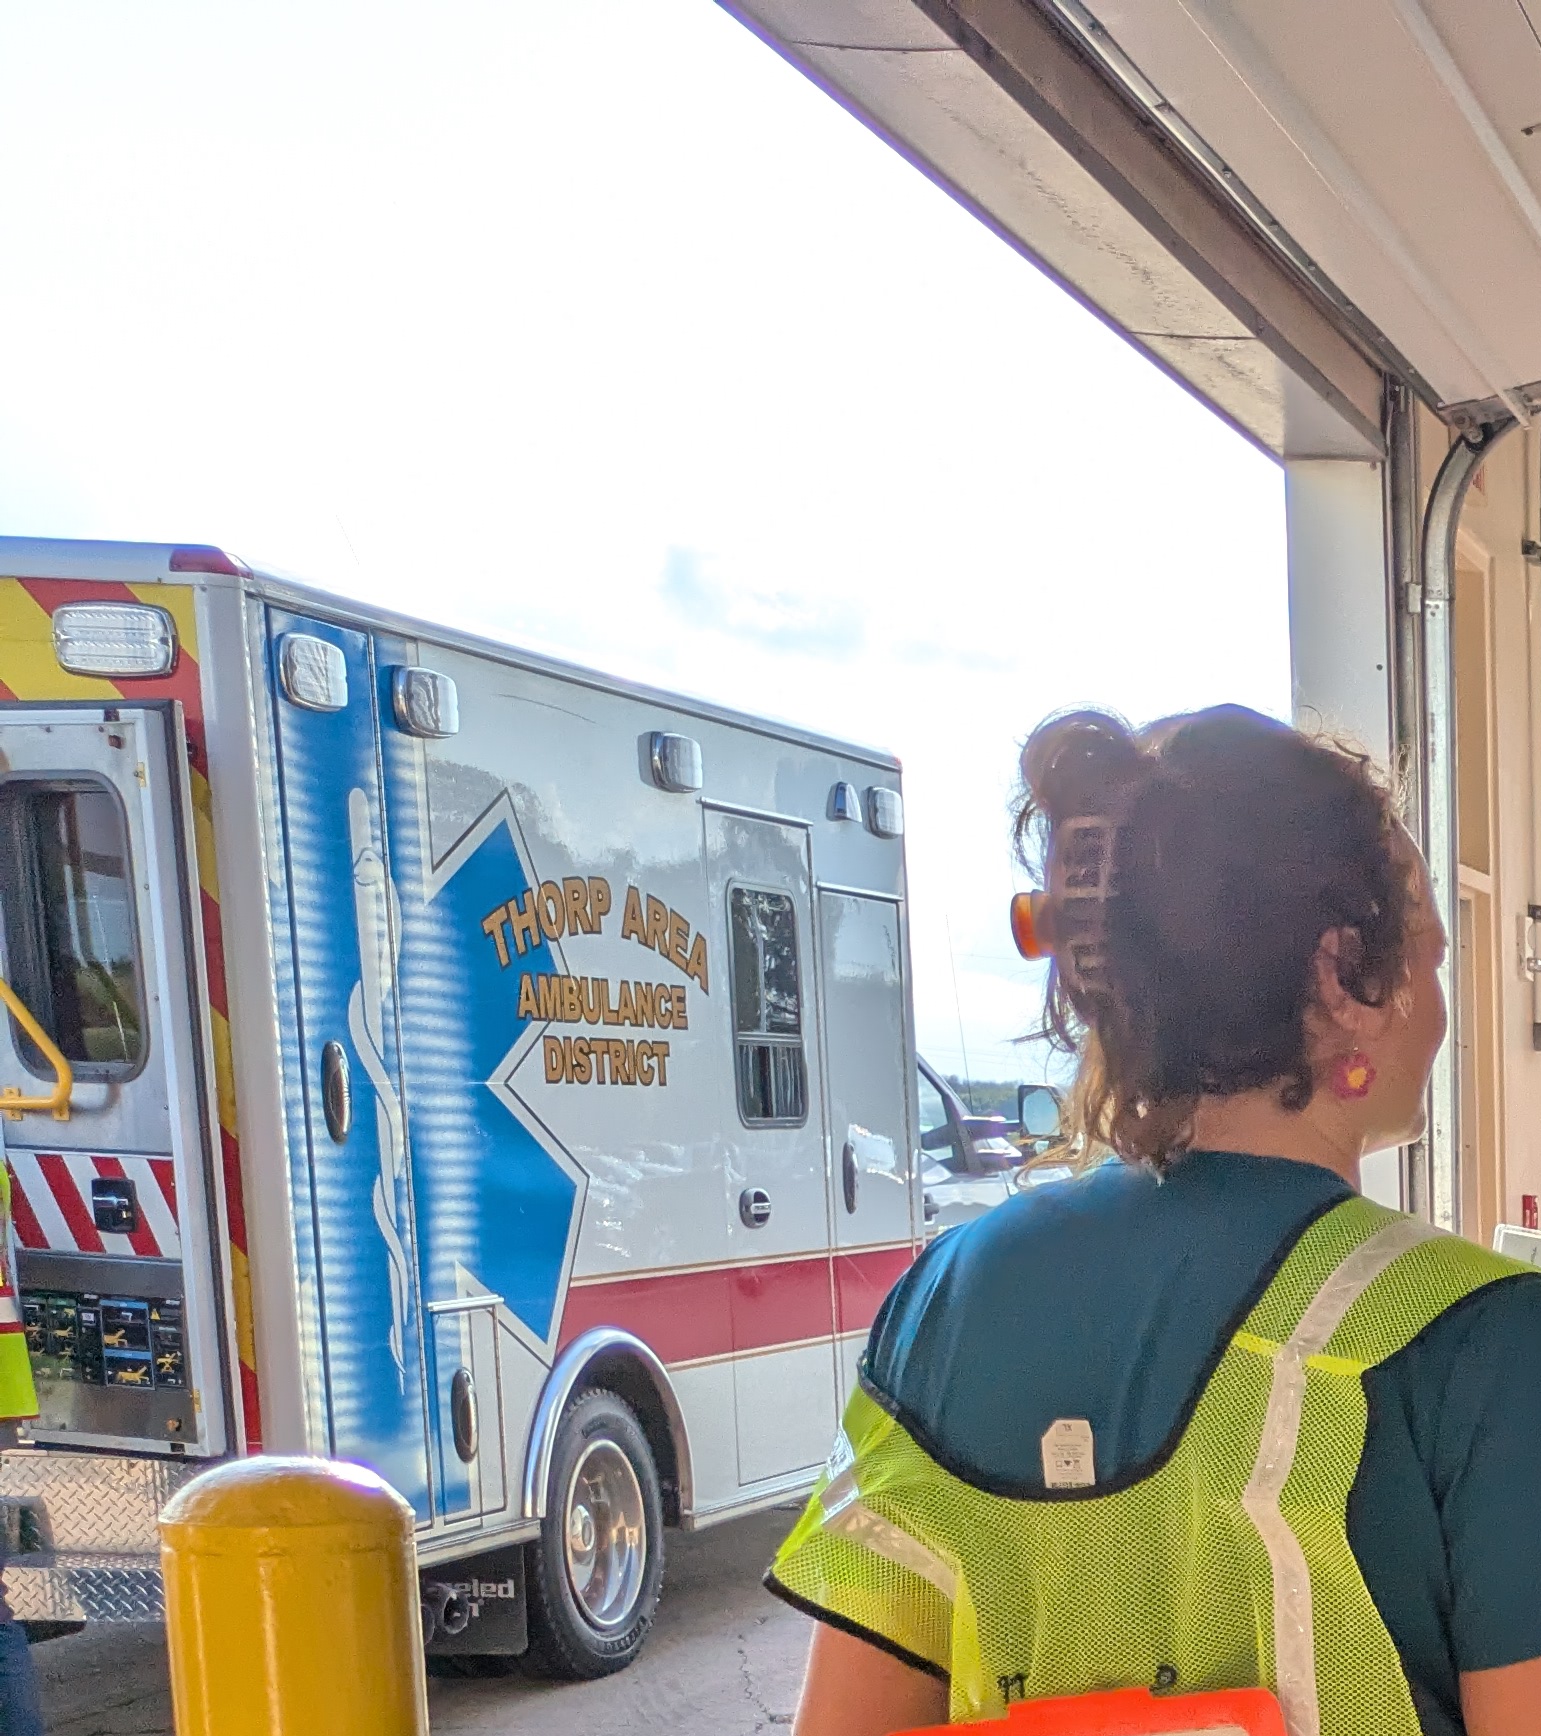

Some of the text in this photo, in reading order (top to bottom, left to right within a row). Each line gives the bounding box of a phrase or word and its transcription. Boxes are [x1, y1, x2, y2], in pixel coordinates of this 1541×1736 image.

[481, 876, 710, 996] THORP AREA
[517, 972, 689, 1030] AMBULANCE
[542, 1035, 670, 1087] DISTRICT
